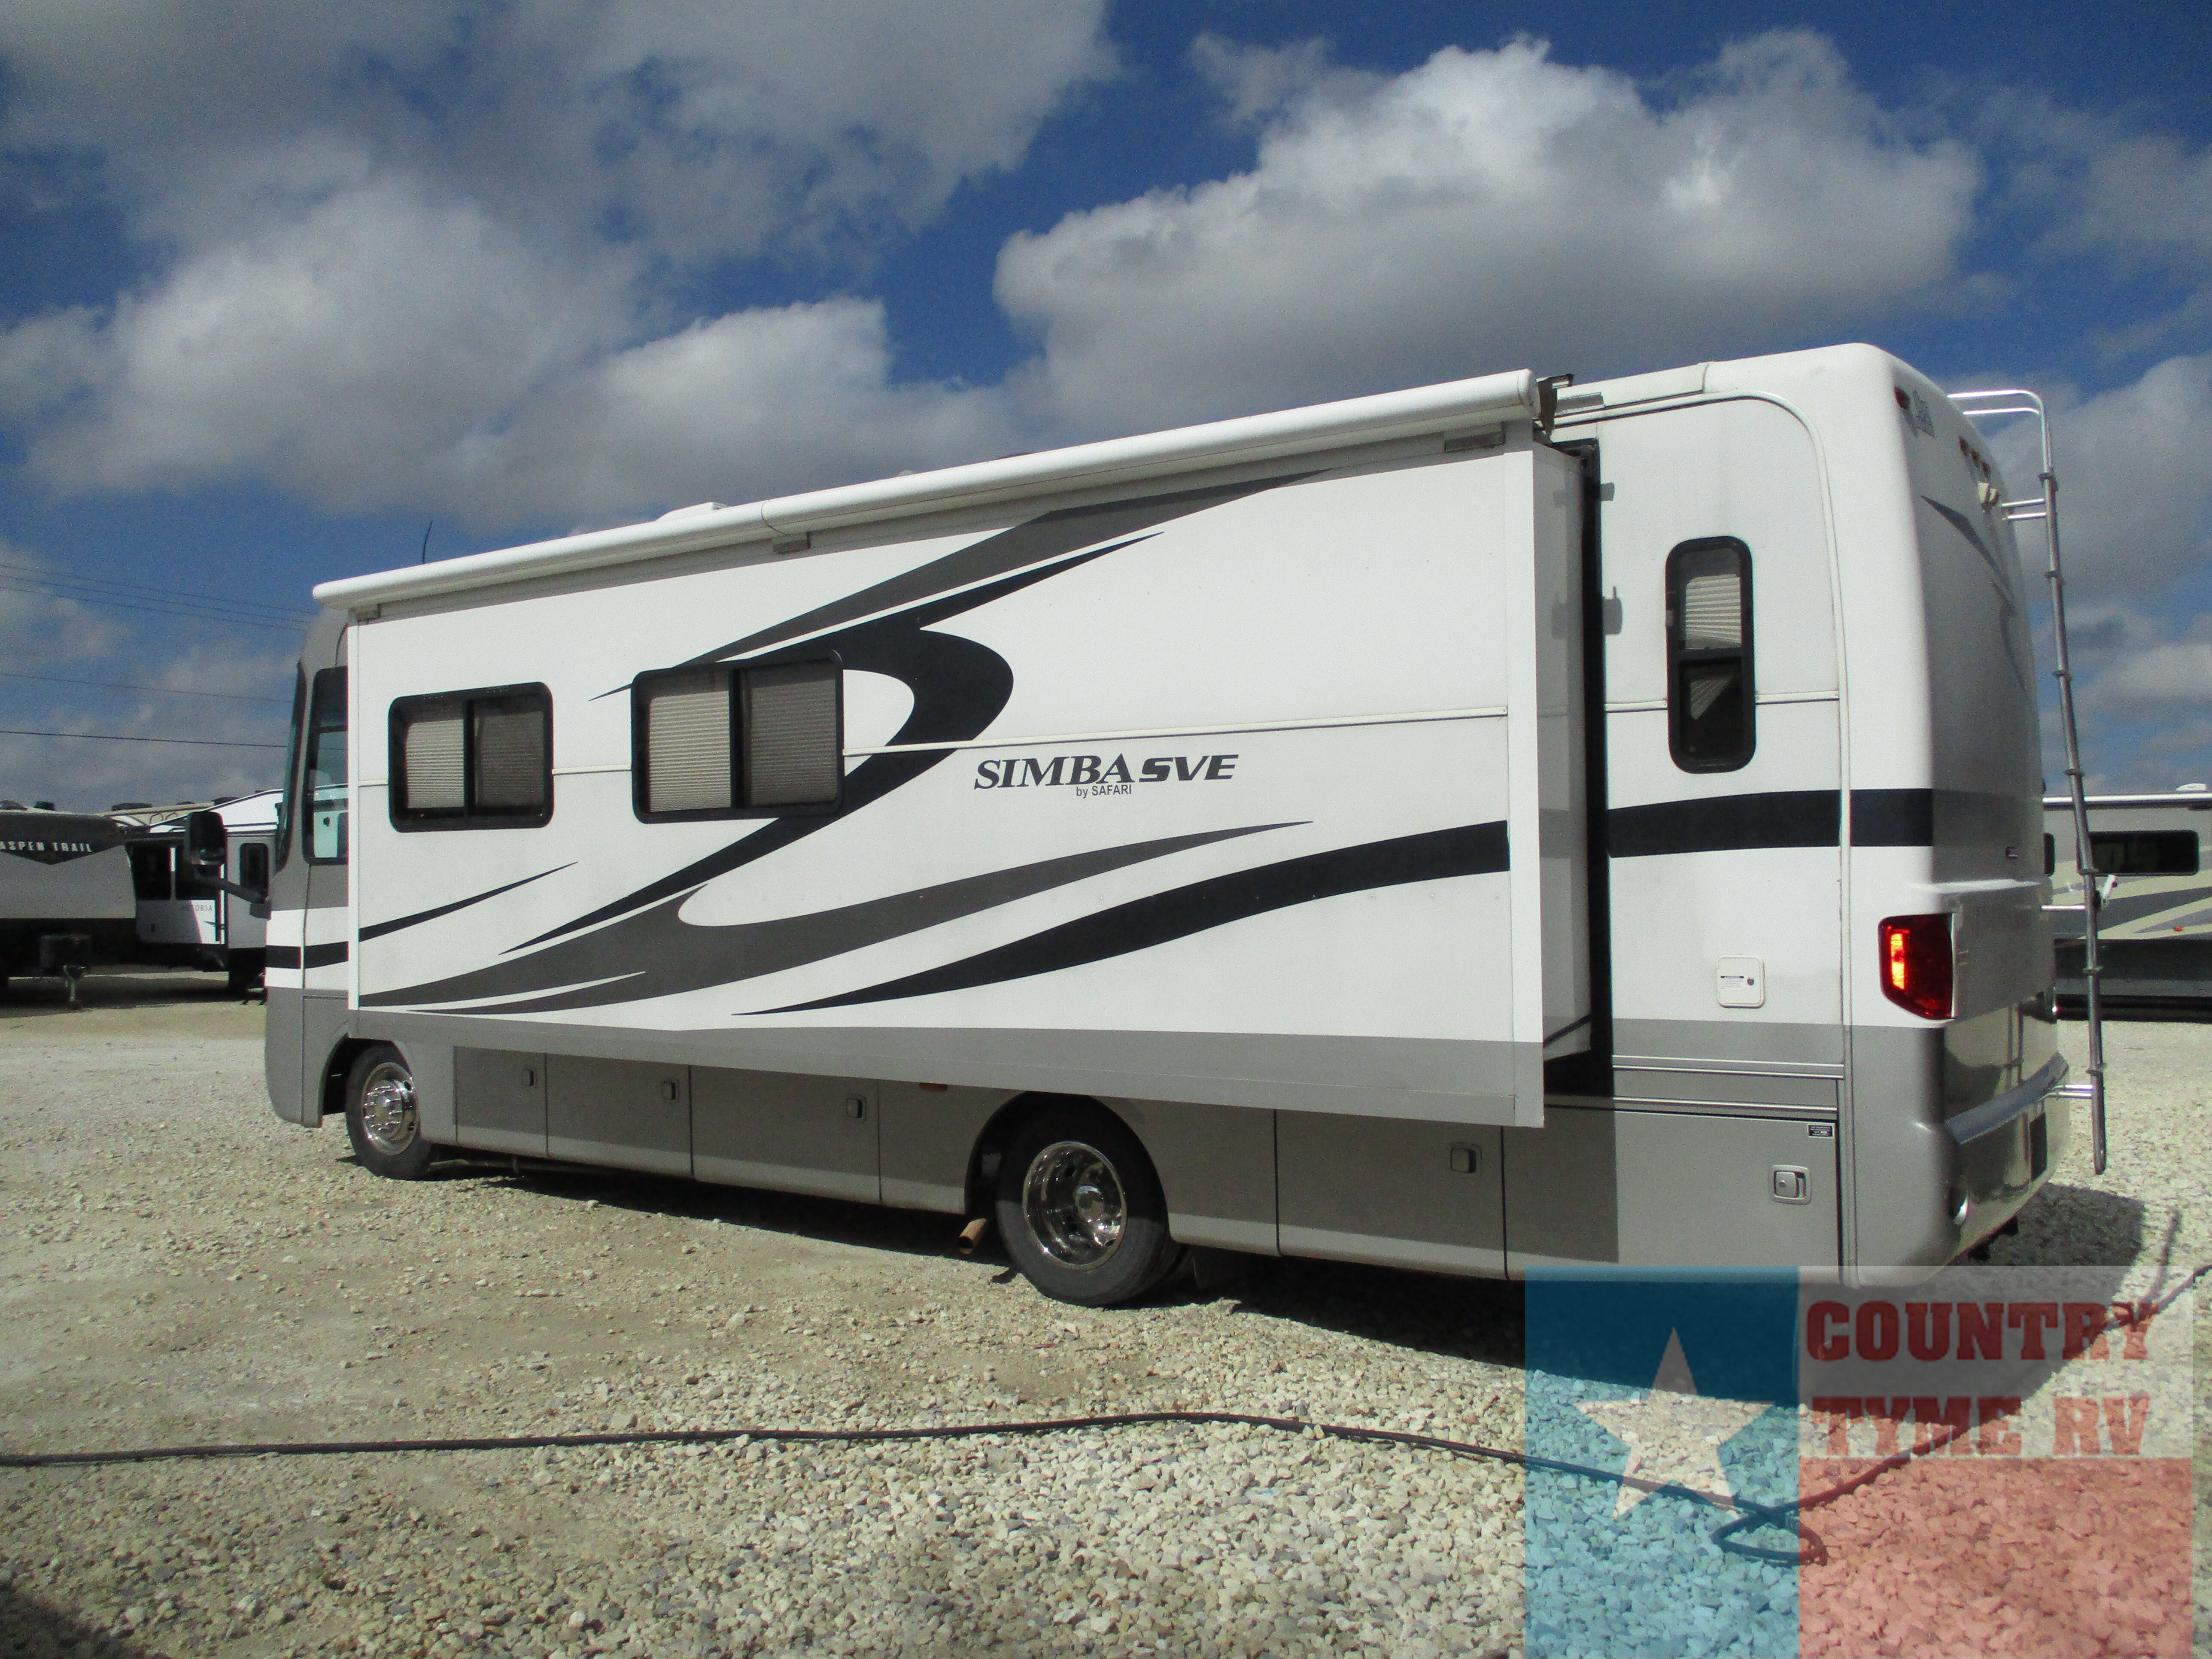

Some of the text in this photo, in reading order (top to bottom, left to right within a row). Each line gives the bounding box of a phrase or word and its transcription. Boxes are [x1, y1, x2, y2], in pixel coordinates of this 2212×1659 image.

[974, 753, 1239, 790] SIMBA SVE
[1076, 784, 1132, 799] by SAFARI
[0, 841, 92, 852] ASPEN TRAIL
